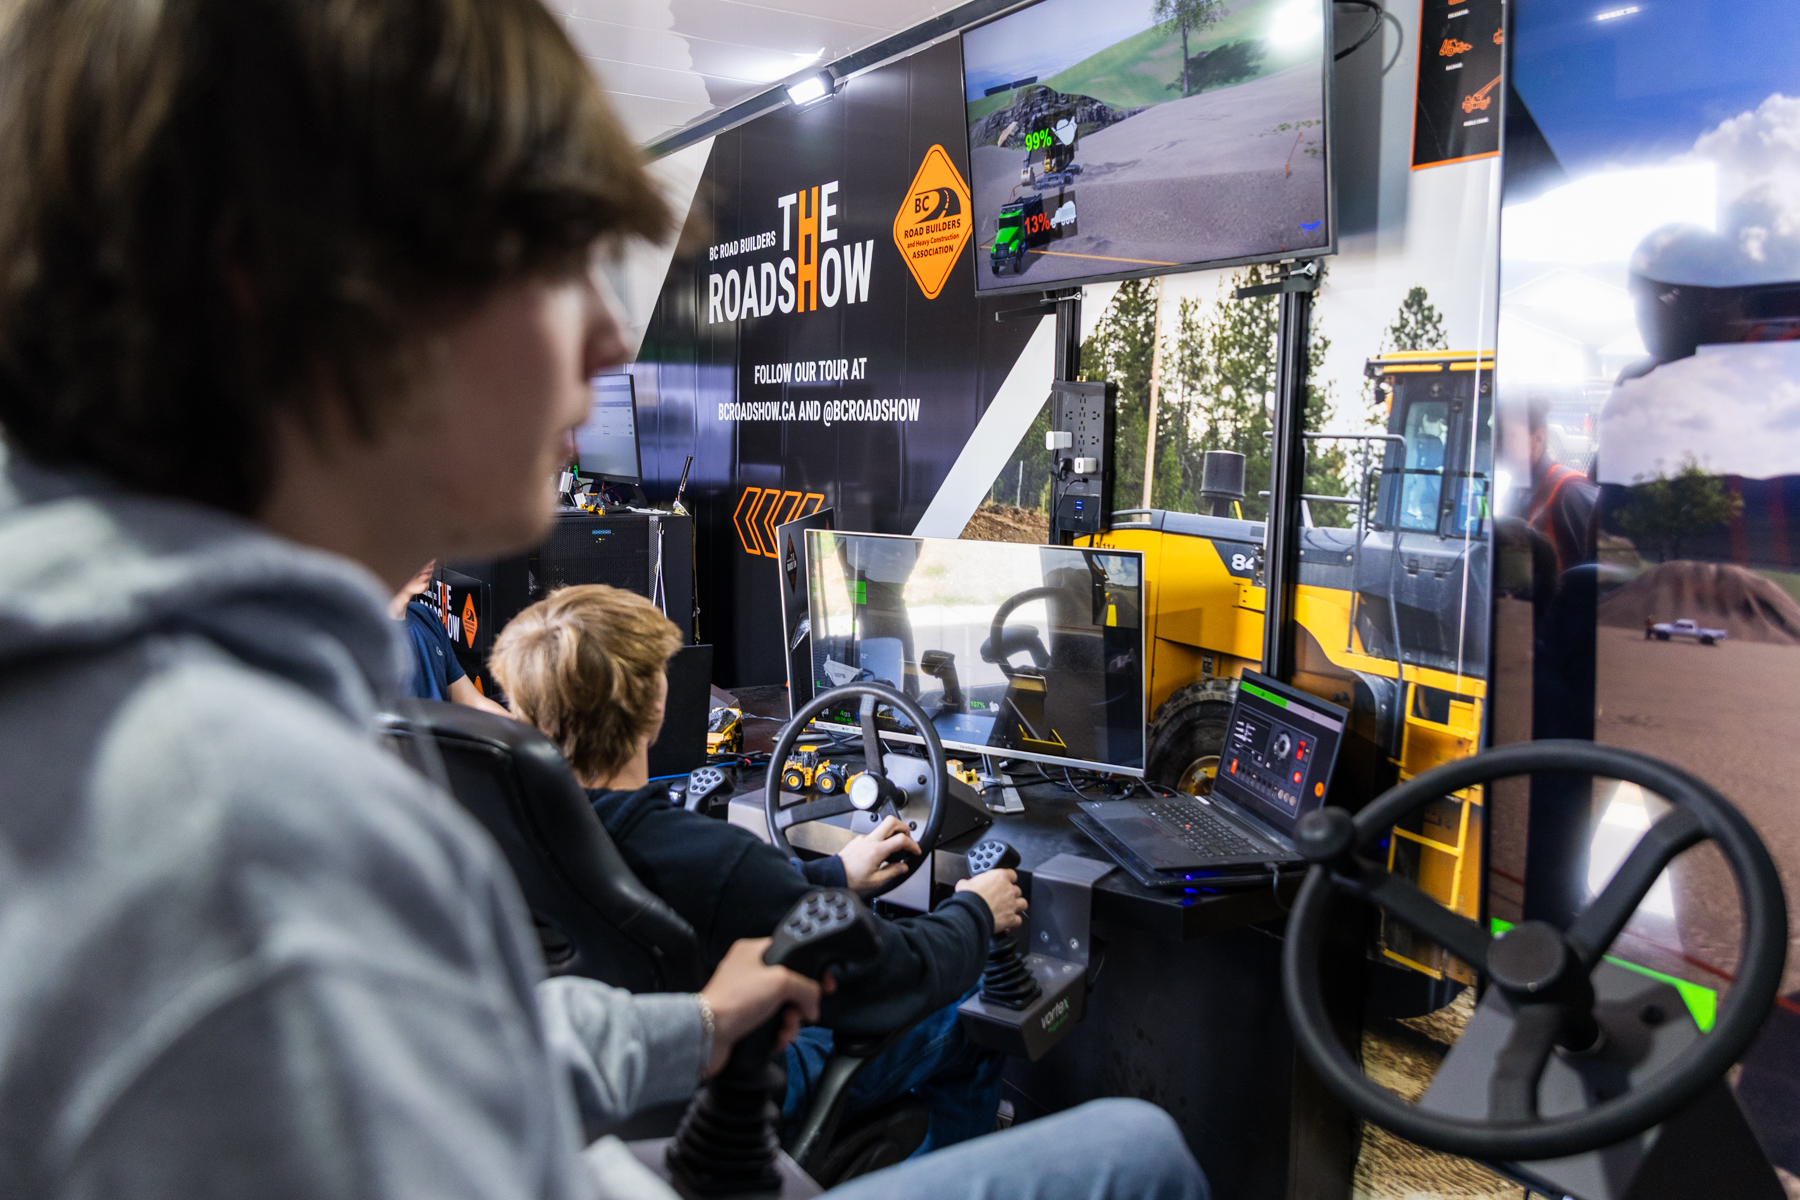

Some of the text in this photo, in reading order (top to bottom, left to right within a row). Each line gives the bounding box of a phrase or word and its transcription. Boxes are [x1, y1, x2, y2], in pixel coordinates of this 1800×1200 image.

[1025, 128, 1052, 152] 99%
[778, 180, 839, 251] THE
[914, 195, 930, 214] BC
[904, 218, 961, 239] ROAD BUILDERS
[1024, 212, 1051, 235] 13%
[709, 230, 776, 261] BC ROAD BUILDERS
[907, 232, 959, 249] and Heavy Construction
[912, 244, 954, 260] ASSOCIATION
[708, 239, 874, 324] ROADSHOW
[754, 357, 867, 385] FOLLOW OUR TOUR AT
[718, 398, 921, 426] BCROADSHOW.CA AND @BCROADSHOW
[436, 580, 452, 611] THE
[1041, 997, 1069, 1029] vortex
